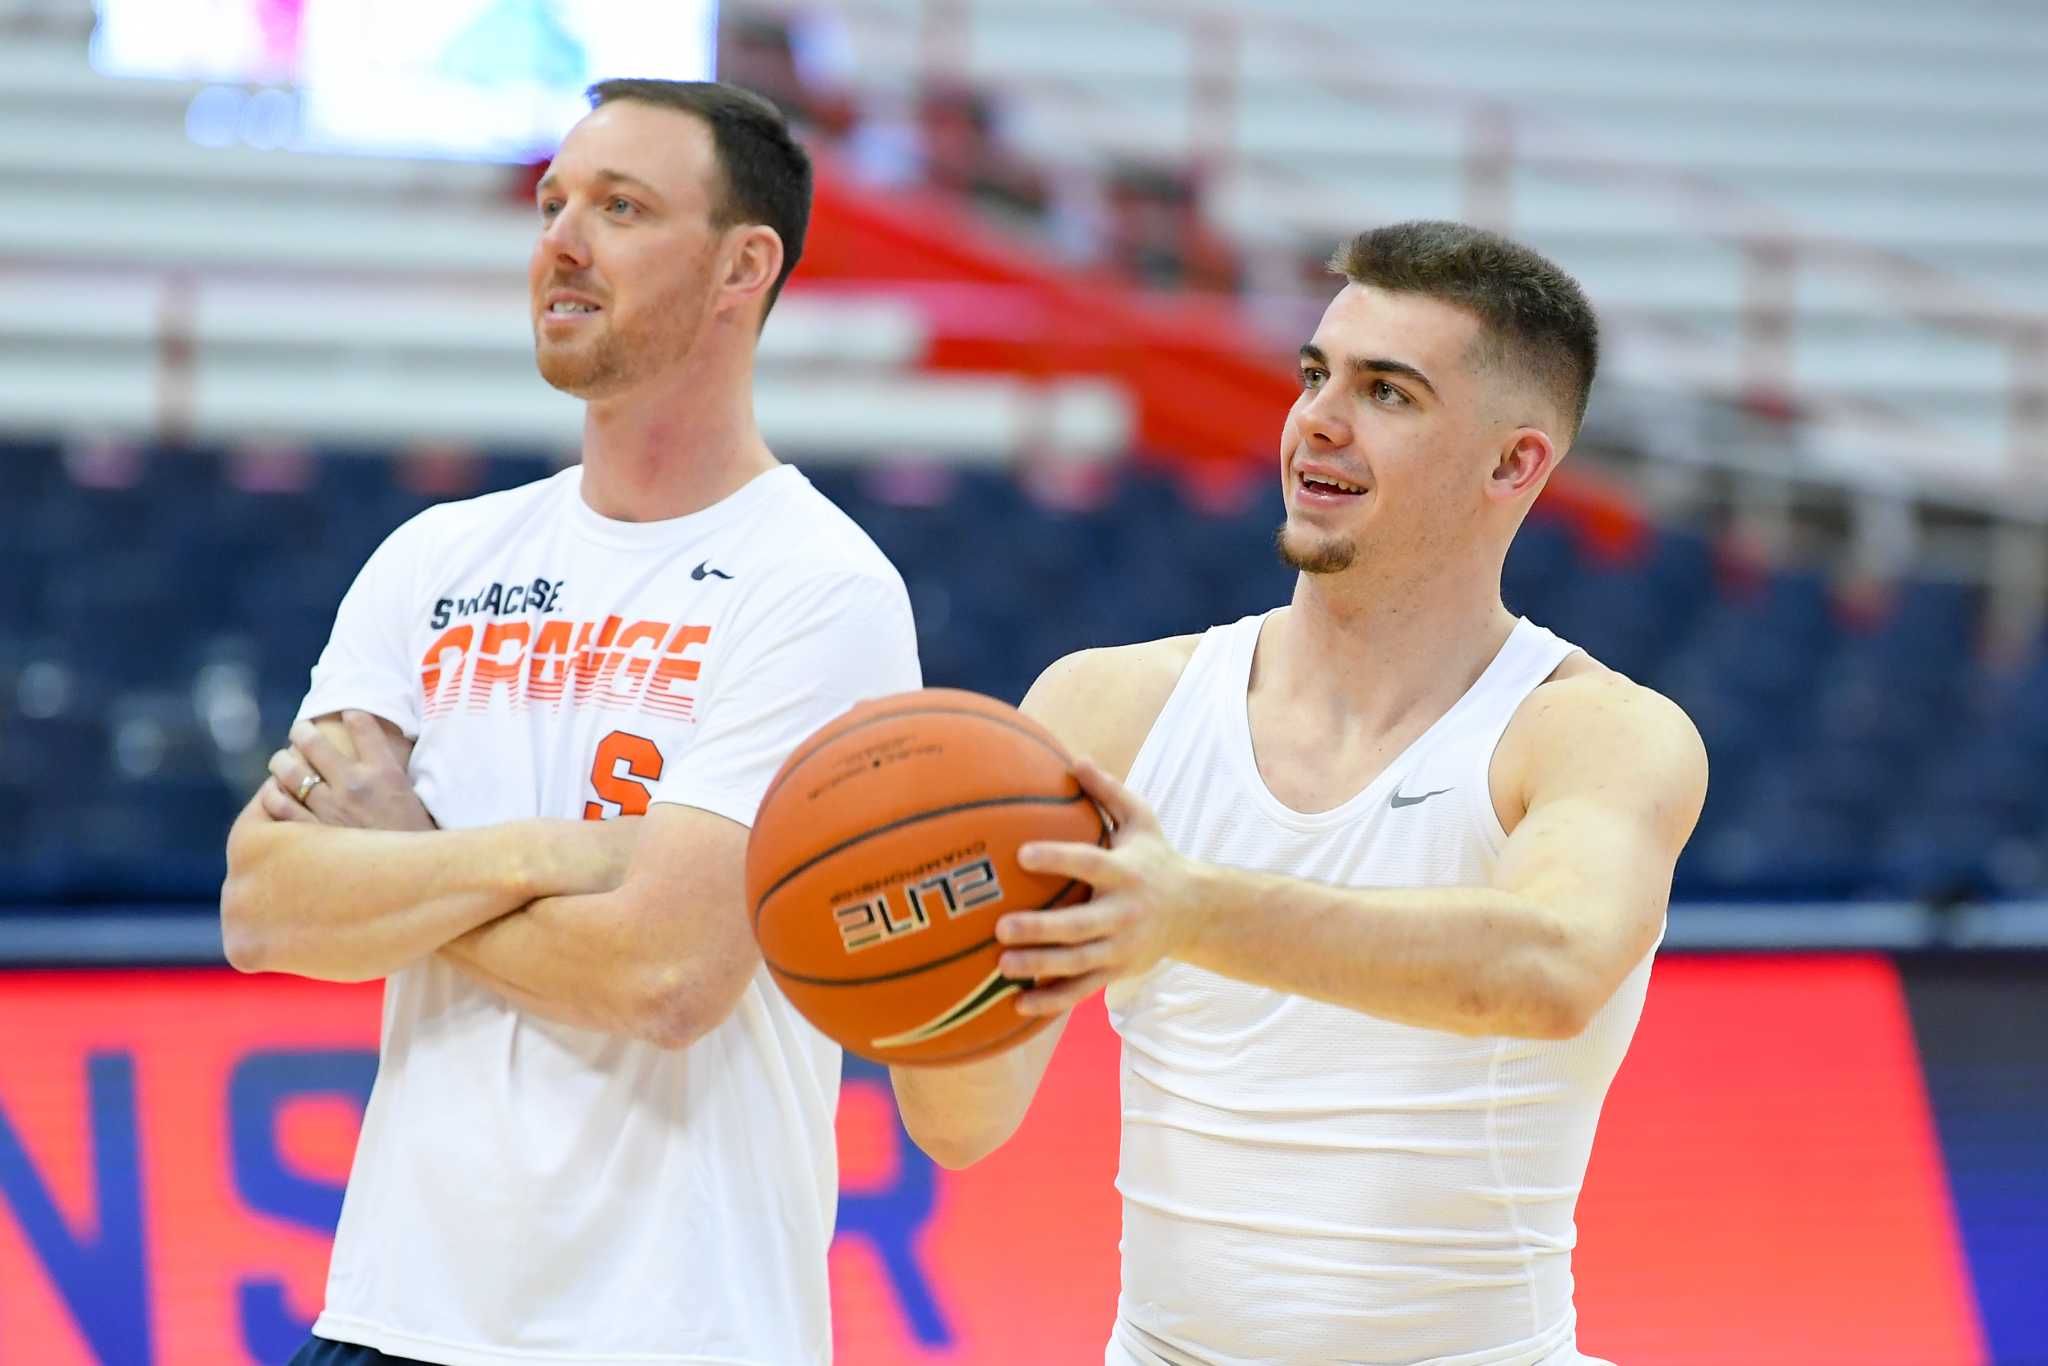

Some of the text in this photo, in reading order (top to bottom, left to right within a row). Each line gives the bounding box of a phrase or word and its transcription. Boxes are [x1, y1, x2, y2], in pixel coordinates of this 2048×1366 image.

[430, 577, 565, 630] SACSE
[421, 614, 712, 722] ORANGE
[583, 729, 664, 821] S
[832, 856, 1003, 954] ELITE
